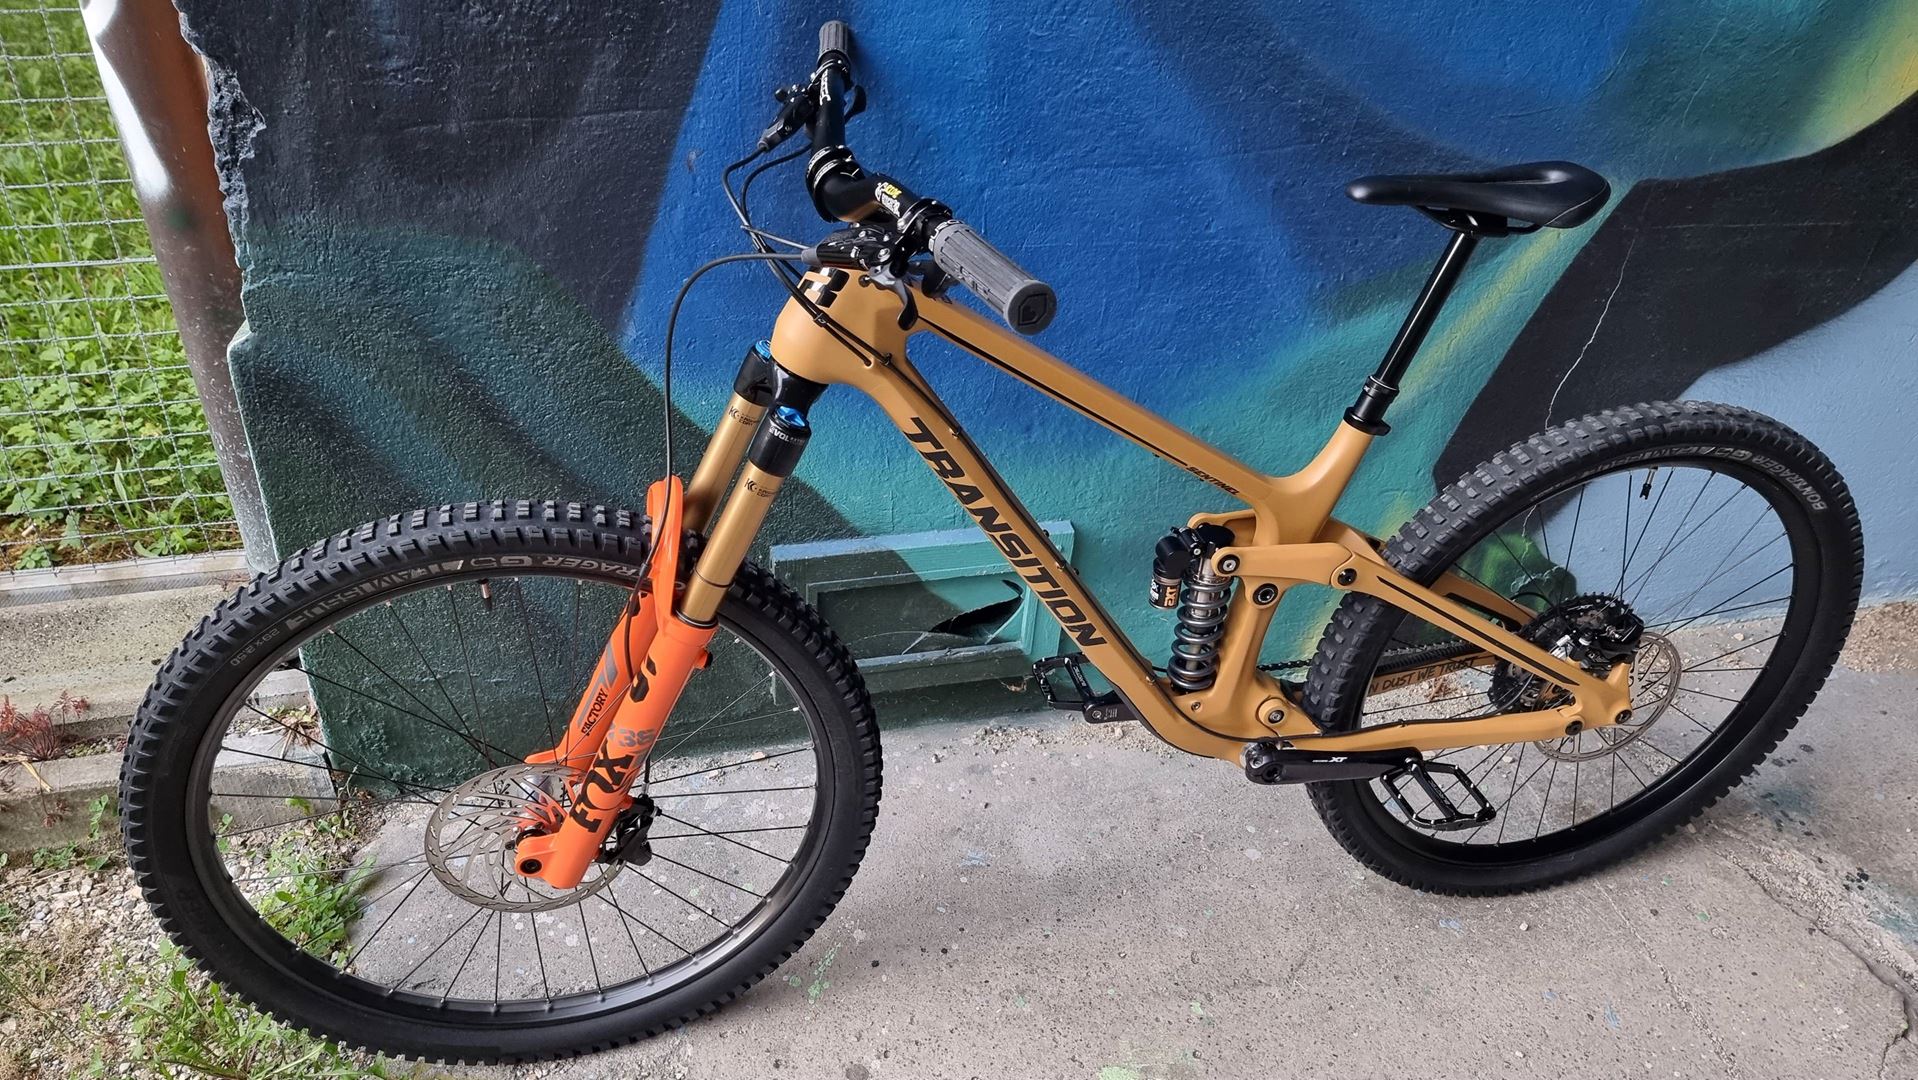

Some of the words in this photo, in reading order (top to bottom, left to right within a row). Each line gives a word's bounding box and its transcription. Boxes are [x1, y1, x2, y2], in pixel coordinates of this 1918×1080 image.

[1186, 466, 1240, 495] SENTINEL
[1751, 454, 1828, 510] BONTRAGER
[903, 416, 1107, 647] TRANSITION
[1382, 672, 1415, 690] DUST
[1417, 666, 1436, 681] WE
[1440, 656, 1479, 677] TRUST
[580, 688, 608, 736] FACTORY
[569, 737, 635, 833] FOX
